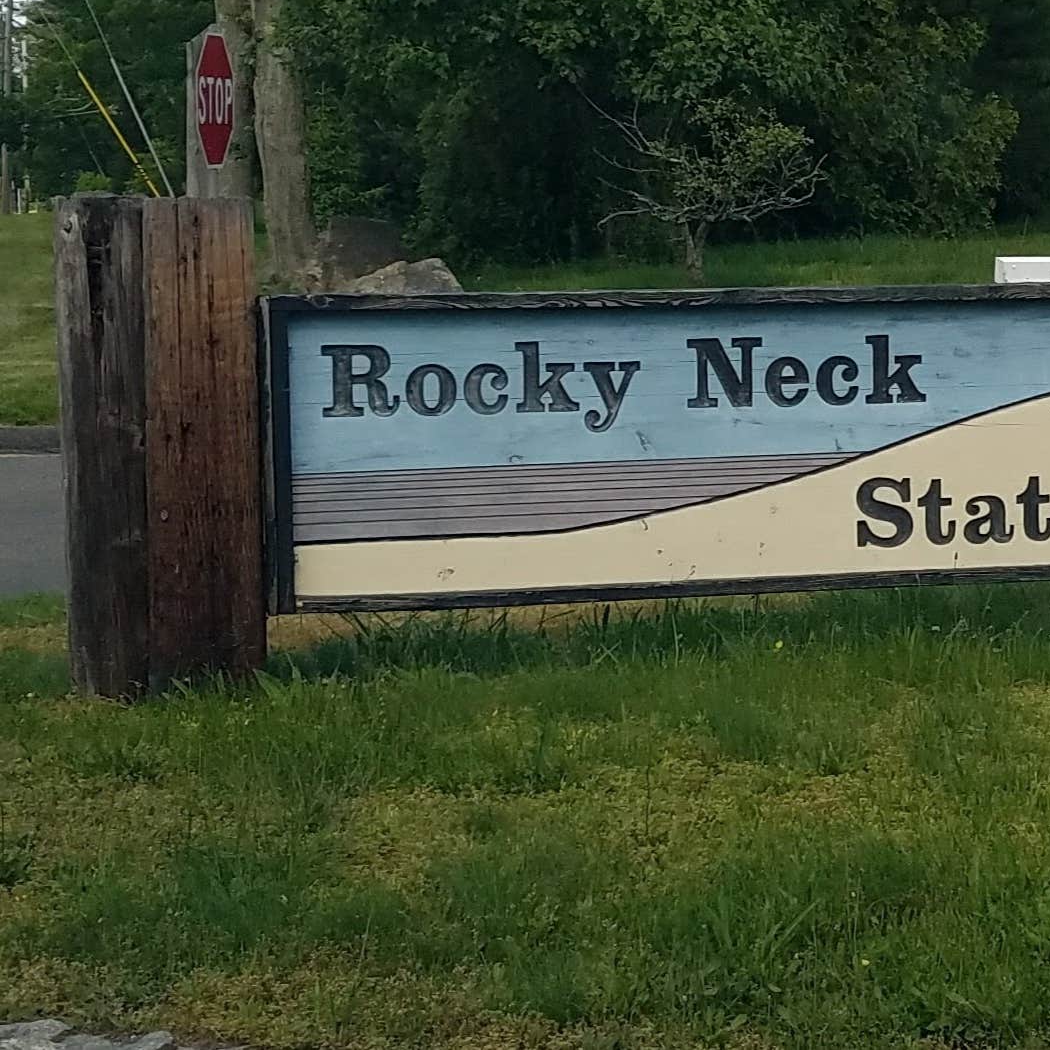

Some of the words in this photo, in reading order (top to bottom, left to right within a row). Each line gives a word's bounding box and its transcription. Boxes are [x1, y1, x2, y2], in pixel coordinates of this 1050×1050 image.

[198, 75, 233, 125] STOP
[320, 341, 640, 432] Rocky
[686, 334, 927, 408] Neck
